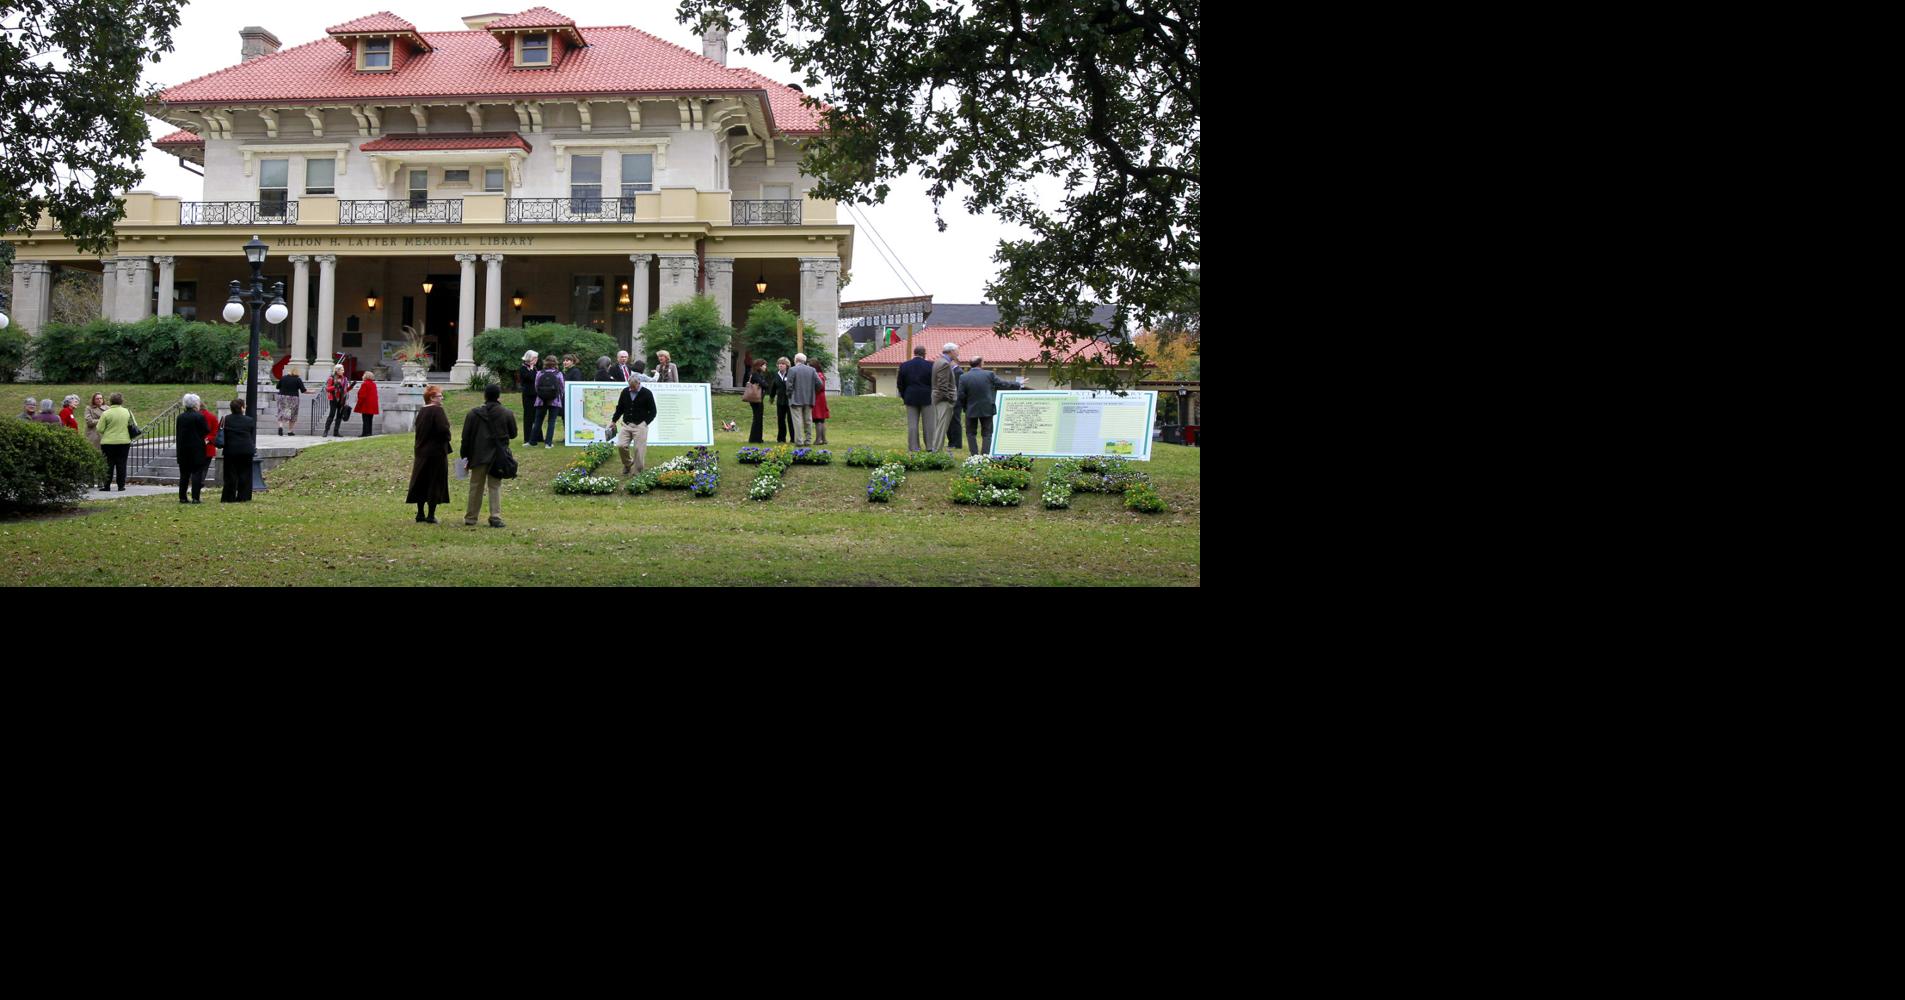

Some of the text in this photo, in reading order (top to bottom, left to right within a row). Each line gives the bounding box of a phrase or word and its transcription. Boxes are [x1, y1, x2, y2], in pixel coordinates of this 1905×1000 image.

[277, 236, 535, 247] MILTON H. LATTER MEMORIAL LIBRARY
